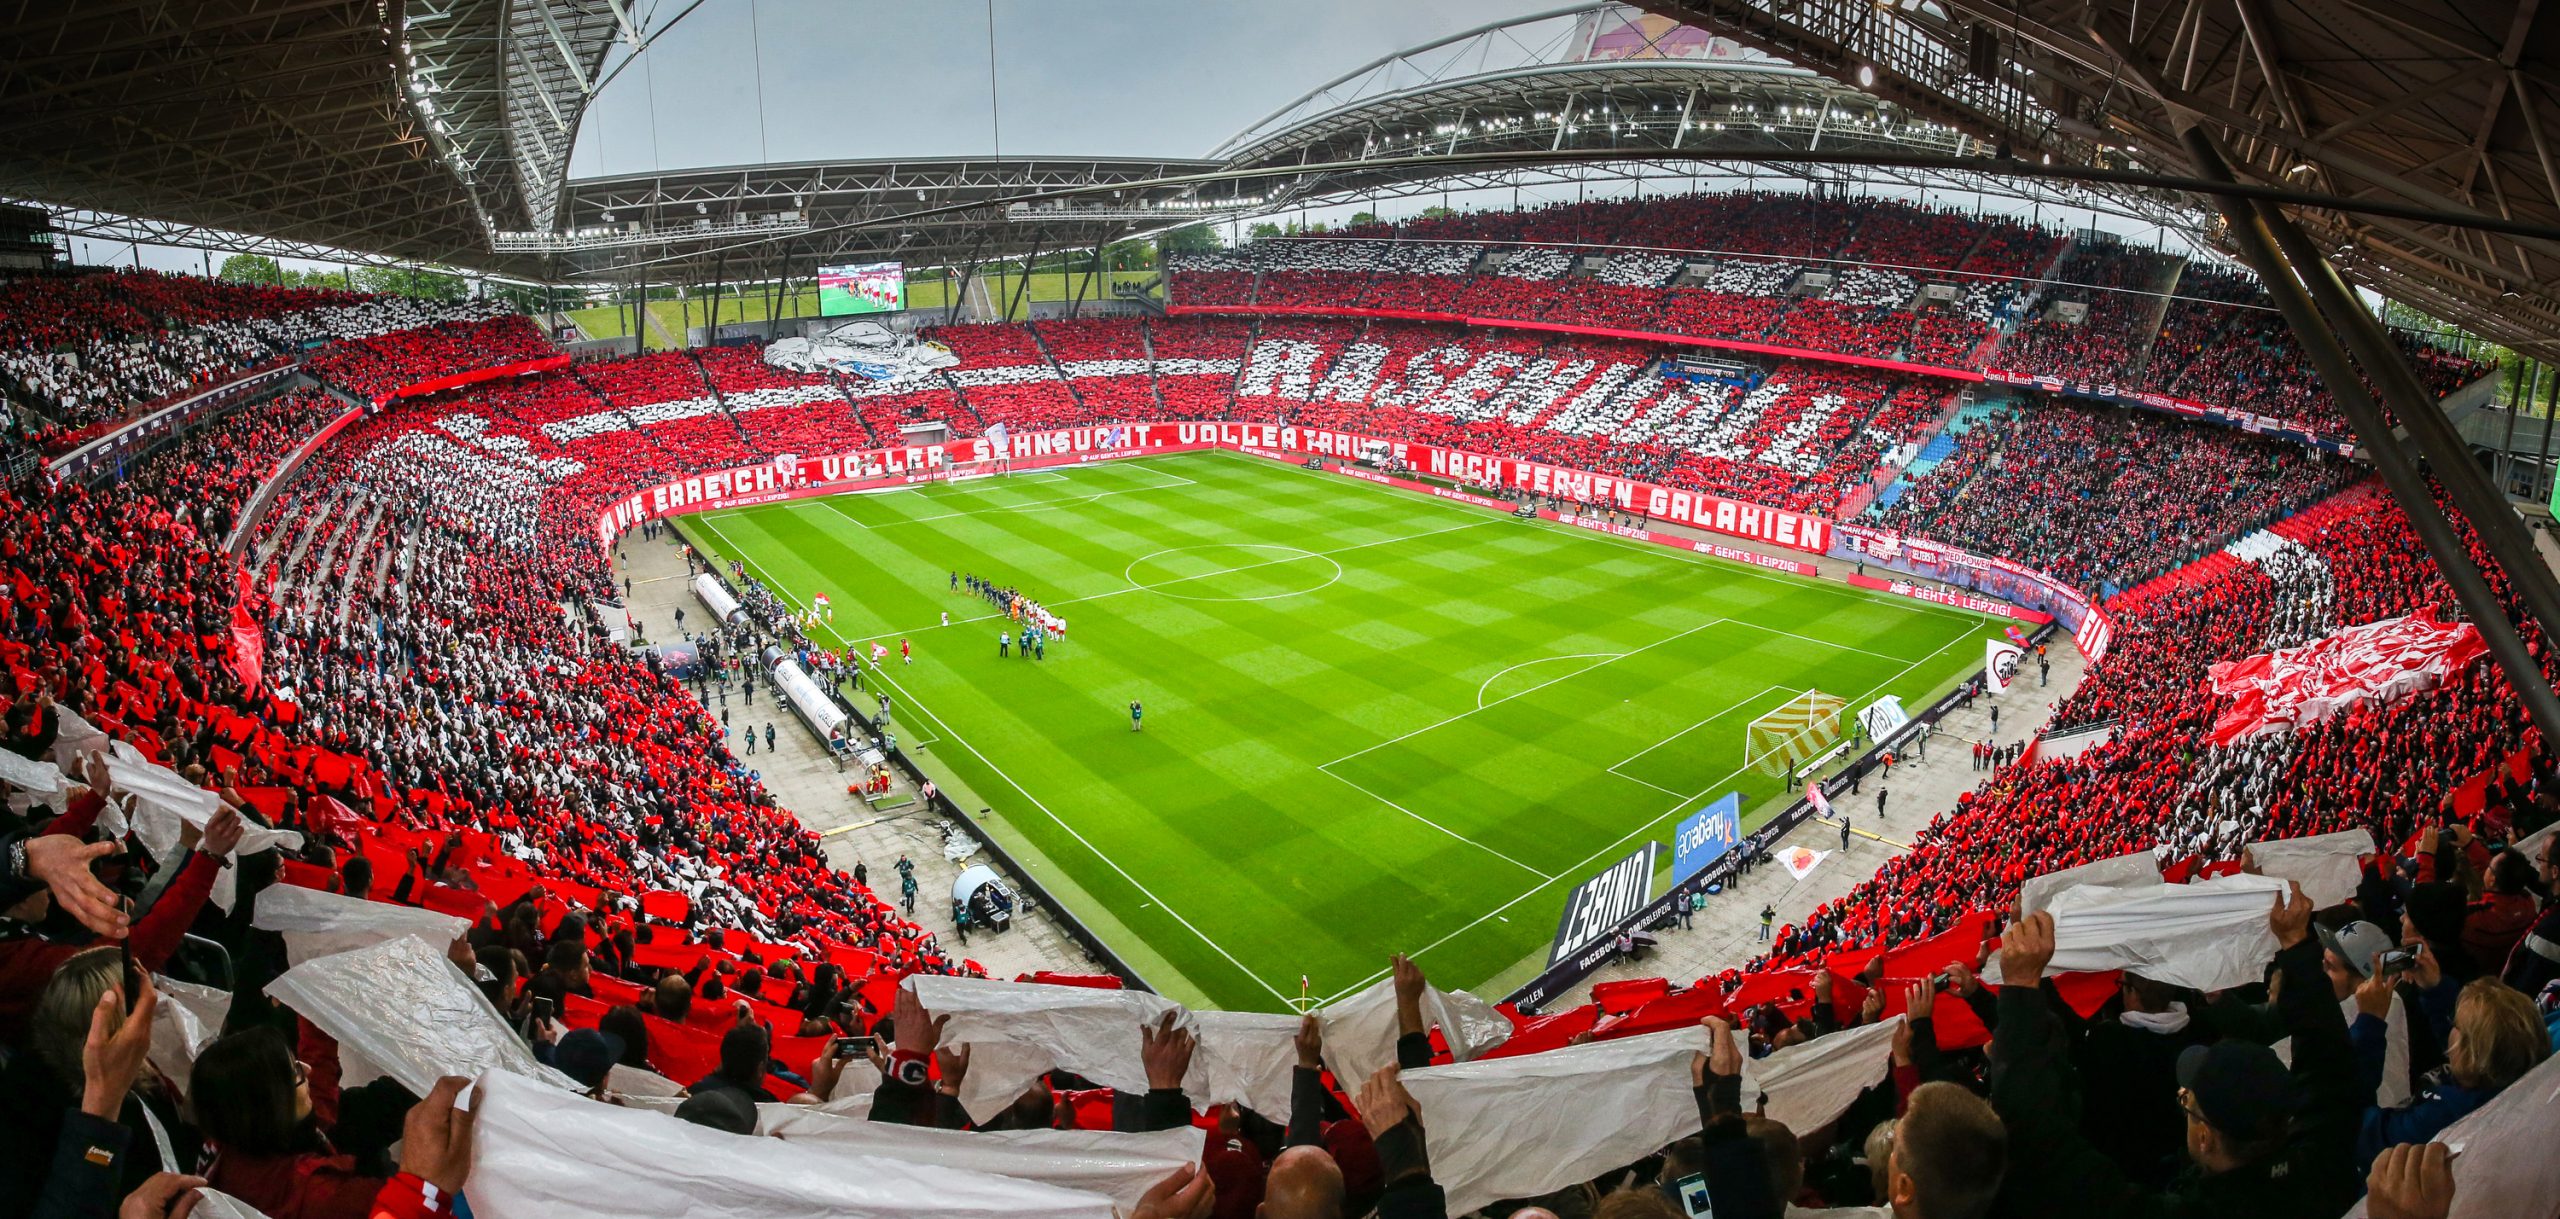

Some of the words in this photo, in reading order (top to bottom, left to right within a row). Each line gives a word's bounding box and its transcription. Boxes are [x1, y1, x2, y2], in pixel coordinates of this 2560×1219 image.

[2007, 369, 2033, 385] United
[2143, 394, 2175, 409] TAUBERTAL
[615, 496, 647, 531] NIE
[822, 446, 944, 481] VOLLER
[1179, 424, 1297, 449] VOLLER
[1431, 449, 1501, 484] NACH
[1650, 488, 1823, 550] GALAXIEN
[1714, 546, 1754, 564] GEHT'S,
[1756, 555, 1799, 572] LEIPZIG!
[1945, 552, 1960, 562] RED
[1961, 553, 1991, 570] POWER
[1914, 588, 1959, 607] GEHT'S,
[1962, 597, 2011, 617] LEIPZIG!
[1678, 810, 1724, 865] fluege.de
[1556, 850, 1645, 962] UNIBET
